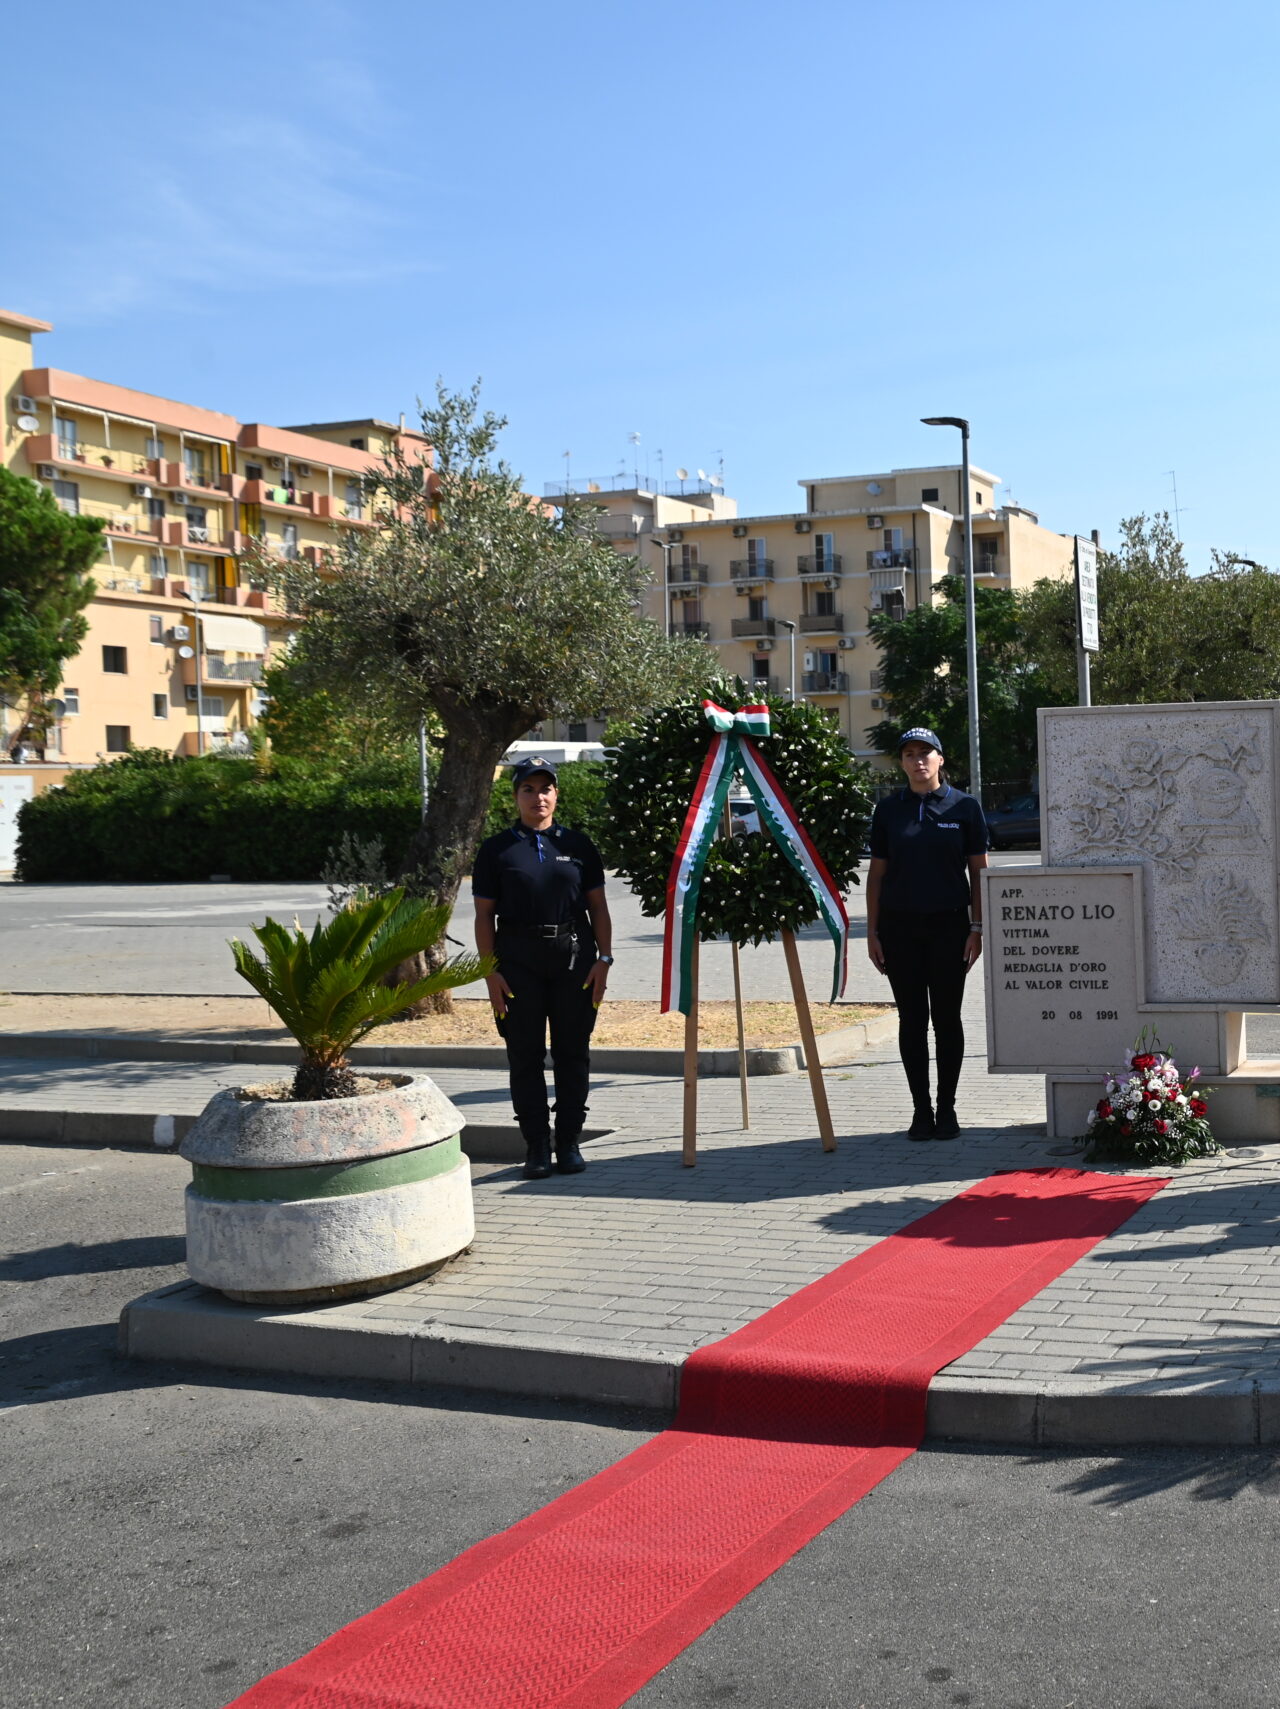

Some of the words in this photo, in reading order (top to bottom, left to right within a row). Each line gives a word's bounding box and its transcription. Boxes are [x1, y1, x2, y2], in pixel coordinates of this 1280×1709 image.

[1000, 888, 1025, 899] APP.
[1001, 905, 1075, 921] RENATO
[1081, 904, 1115, 920] LIO
[1002, 928, 1050, 939] VITTIMA
[1002, 945, 1026, 956] DEL
[1031, 945, 1080, 956] DOVERE
[1003, 962, 1064, 973] MEDAGLIA
[1069, 962, 1107, 973] D'ORO
[1004, 980, 1020, 991] AL
[1024, 979, 1063, 990] VALOR
[1068, 979, 1109, 990] CIVILE
[1041, 1010, 1056, 1021] 20
[1068, 1010, 1083, 1021] 08
[1096, 1010, 1119, 1021] 1991
